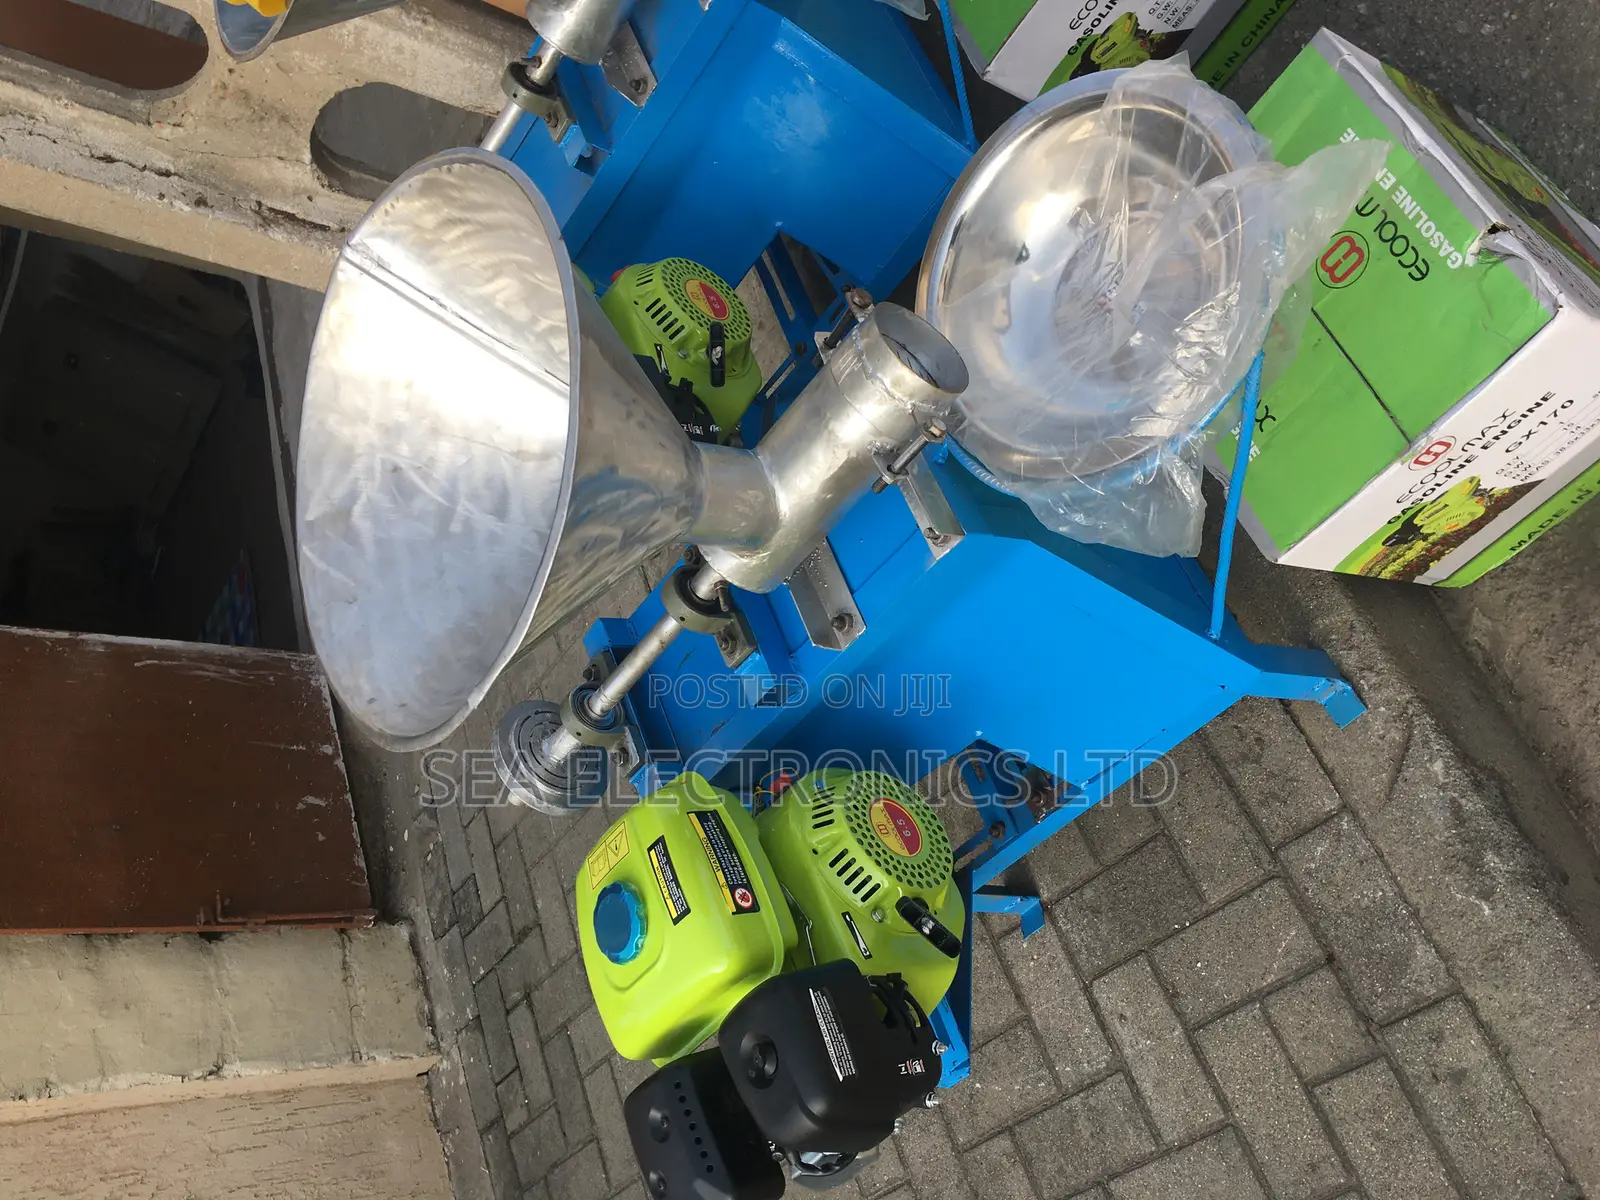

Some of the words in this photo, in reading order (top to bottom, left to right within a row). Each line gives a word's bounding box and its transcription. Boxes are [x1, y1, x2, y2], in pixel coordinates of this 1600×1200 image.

[1224, 51, 1240, 68] IN
[1373, 209, 1430, 281] ECOOL
[1391, 185, 1463, 269] GASOLINE
[1387, 454, 1479, 524] GASOLINE
[1480, 391, 1556, 450] ENGINE
[1509, 508, 1568, 551] MADE
[1570, 484, 1593, 504] IN
[701, 836, 720, 872] WARNING
